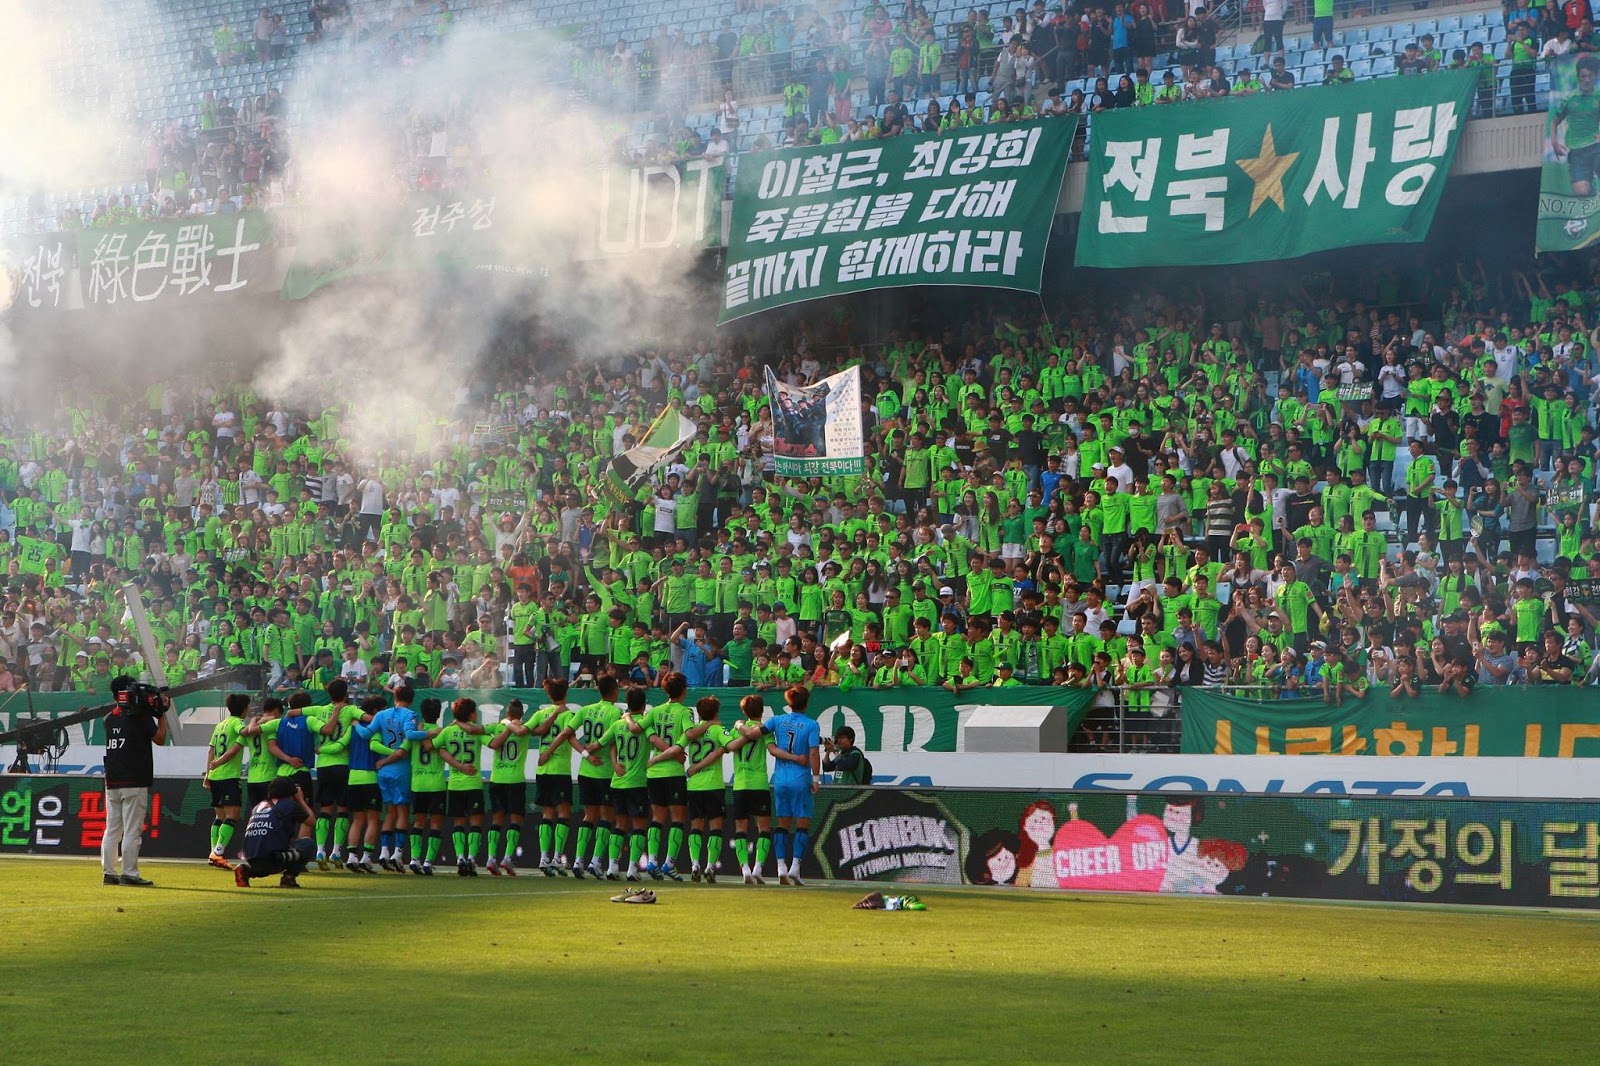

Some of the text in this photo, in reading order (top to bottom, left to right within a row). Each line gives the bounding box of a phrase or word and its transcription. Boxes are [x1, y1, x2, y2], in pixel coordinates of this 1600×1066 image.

[757, 127, 1042, 200] 이철근, 최강희
[1099, 101, 1458, 234] 전북 사랑
[746, 180, 1017, 243] 죽을힘을 다해
[88, 218, 260, 304] 綠色戰士
[725, 230, 1023, 309] 끝까지 함께하라
[112, 727, 121, 735] TV
[449, 740, 476, 764] 25
[616, 734, 640, 762] 20
[691, 738, 716, 764] 22
[838, 815, 955, 868] JEONBUK
[1055, 840, 1168, 878] CHEER UP!
[1327, 815, 1600, 897] 가정의 달
